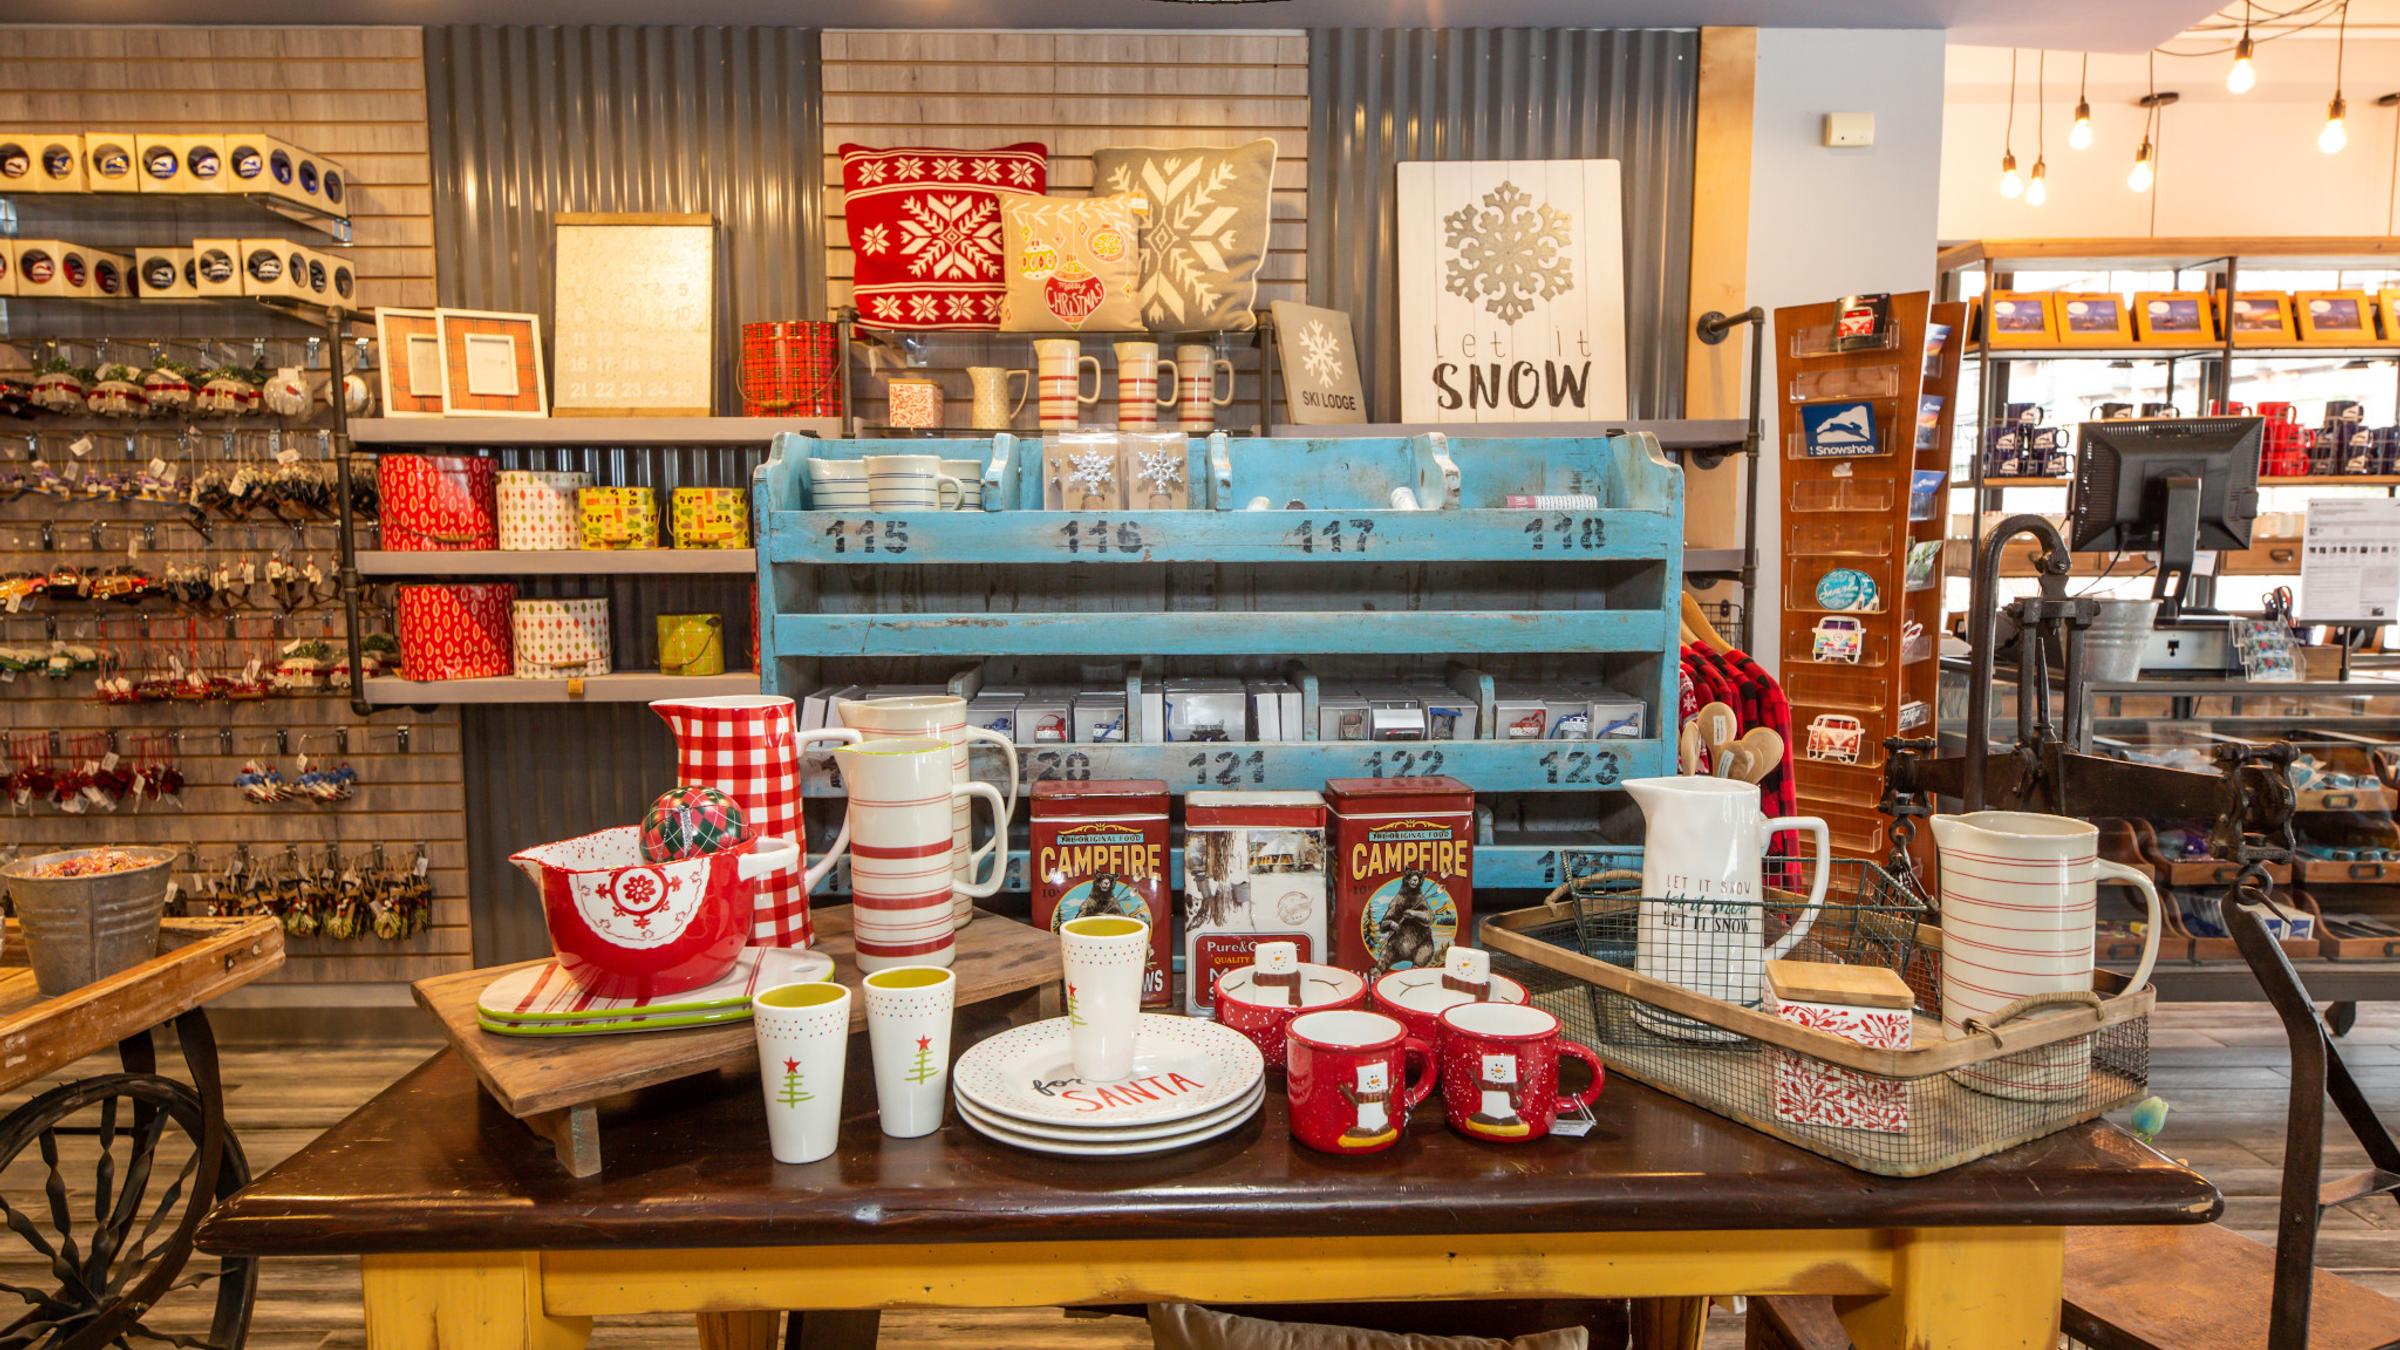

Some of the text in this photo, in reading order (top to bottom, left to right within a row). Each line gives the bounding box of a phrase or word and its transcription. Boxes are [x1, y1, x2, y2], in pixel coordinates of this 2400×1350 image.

[1046, 283, 1103, 316] CHRISTMAS
[1434, 324, 1592, 358] Let it
[571, 382, 587, 398] 21
[594, 382, 615, 398] 22
[622, 382, 641, 398] 23
[649, 382, 669, 397] 24
[1302, 390, 1356, 410] SKI LODGE
[1432, 359, 1592, 410] SNOW
[1816, 444, 1875, 456] Snowshoe
[826, 520, 908, 553] 115
[1059, 520, 1143, 553] 116
[1294, 519, 1374, 553] 117
[1524, 518, 1605, 550] 118
[1188, 750, 1264, 784] 121
[1364, 750, 1445, 778] 122
[1539, 751, 1619, 785] 123
[1040, 844, 1162, 884] CAMPFIRE
[1352, 840, 1468, 881] CAMPFIRE
[1699, 880, 1711, 893] IT
[1715, 917, 1750, 933] SNOW
[1214, 956, 1250, 965] QUALITY
[1032, 1072, 1205, 1113] for SANTA
